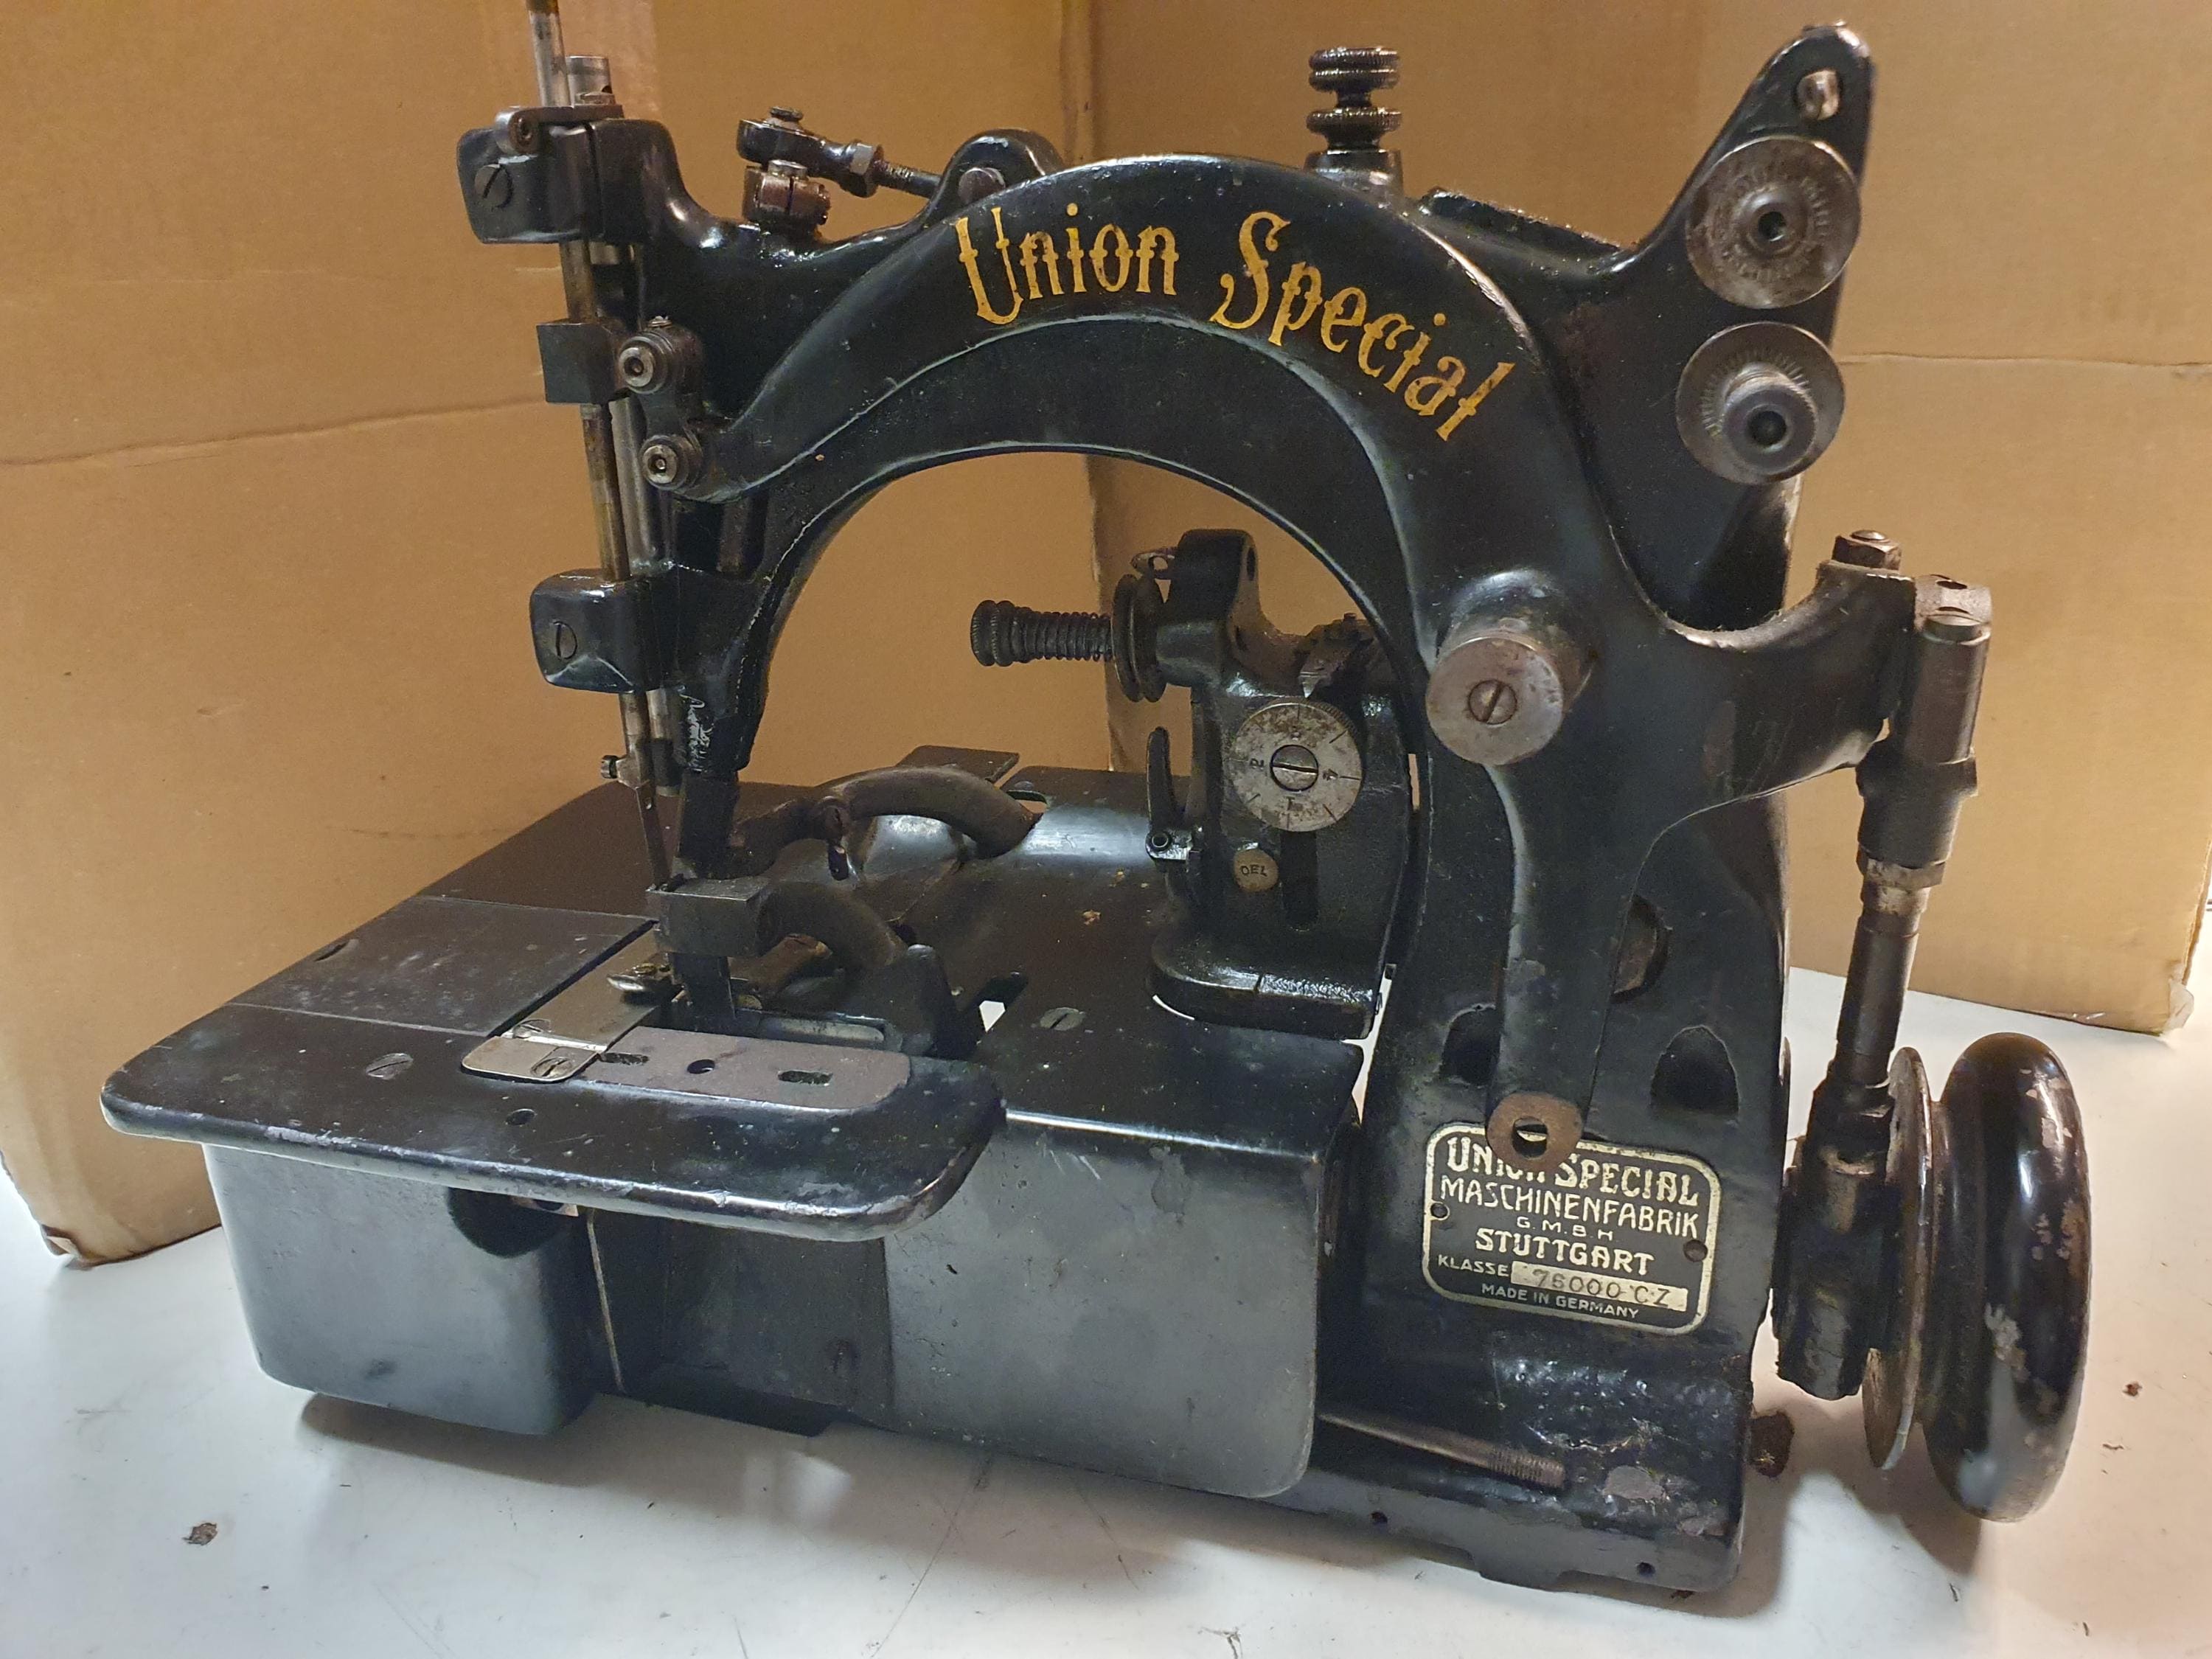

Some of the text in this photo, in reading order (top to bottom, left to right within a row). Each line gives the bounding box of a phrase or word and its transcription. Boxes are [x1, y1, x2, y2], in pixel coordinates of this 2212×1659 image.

[954, 202, 1516, 442] Union Special
[1239, 864, 1267, 877] OEL
[1446, 1136, 1700, 1206] UNI SPECIAL
[1440, 1175, 1699, 1239] MASCHINENFABRIK
[1438, 1254, 1509, 1278] KLASSE
[1475, 1227, 1655, 1276] STUTTGART
[1481, 1283, 1640, 1319] MADE IN GERMANY
